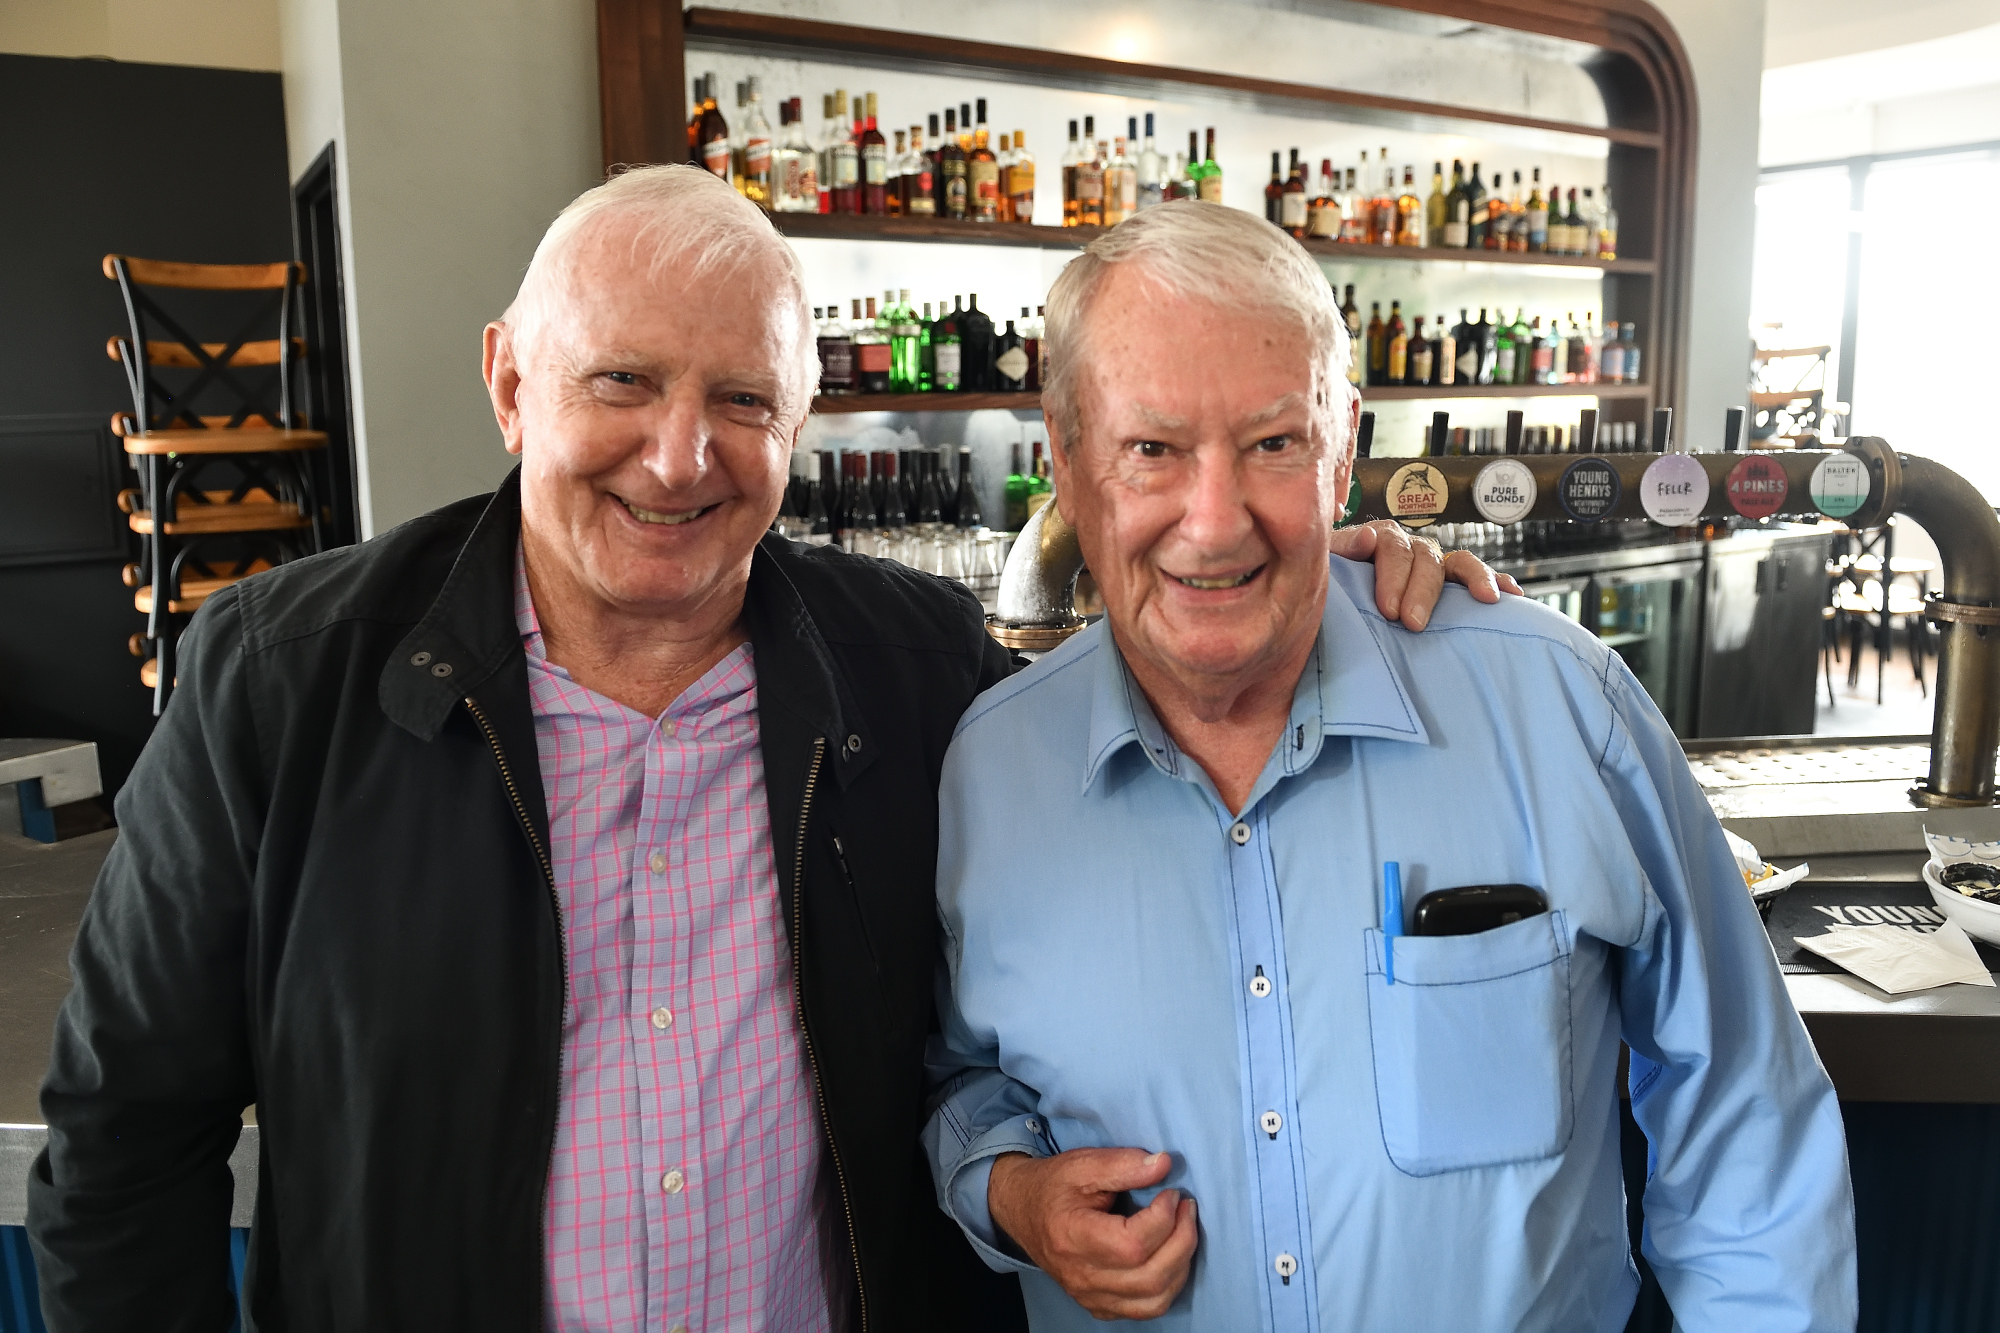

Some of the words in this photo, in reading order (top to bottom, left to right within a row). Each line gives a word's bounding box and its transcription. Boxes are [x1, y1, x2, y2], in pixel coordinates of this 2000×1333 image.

[1573, 471, 1609, 484] YOUNG
[1492, 486, 1518, 495] PURE
[1569, 484, 1611, 497] HENRYS
[1731, 481, 1740, 492] 4
[1743, 479, 1785, 493] PINES
[1398, 493, 1436, 504] GREAT
[1484, 495, 1525, 503] BLONDE
[1398, 502, 1437, 510] NORTHERN
